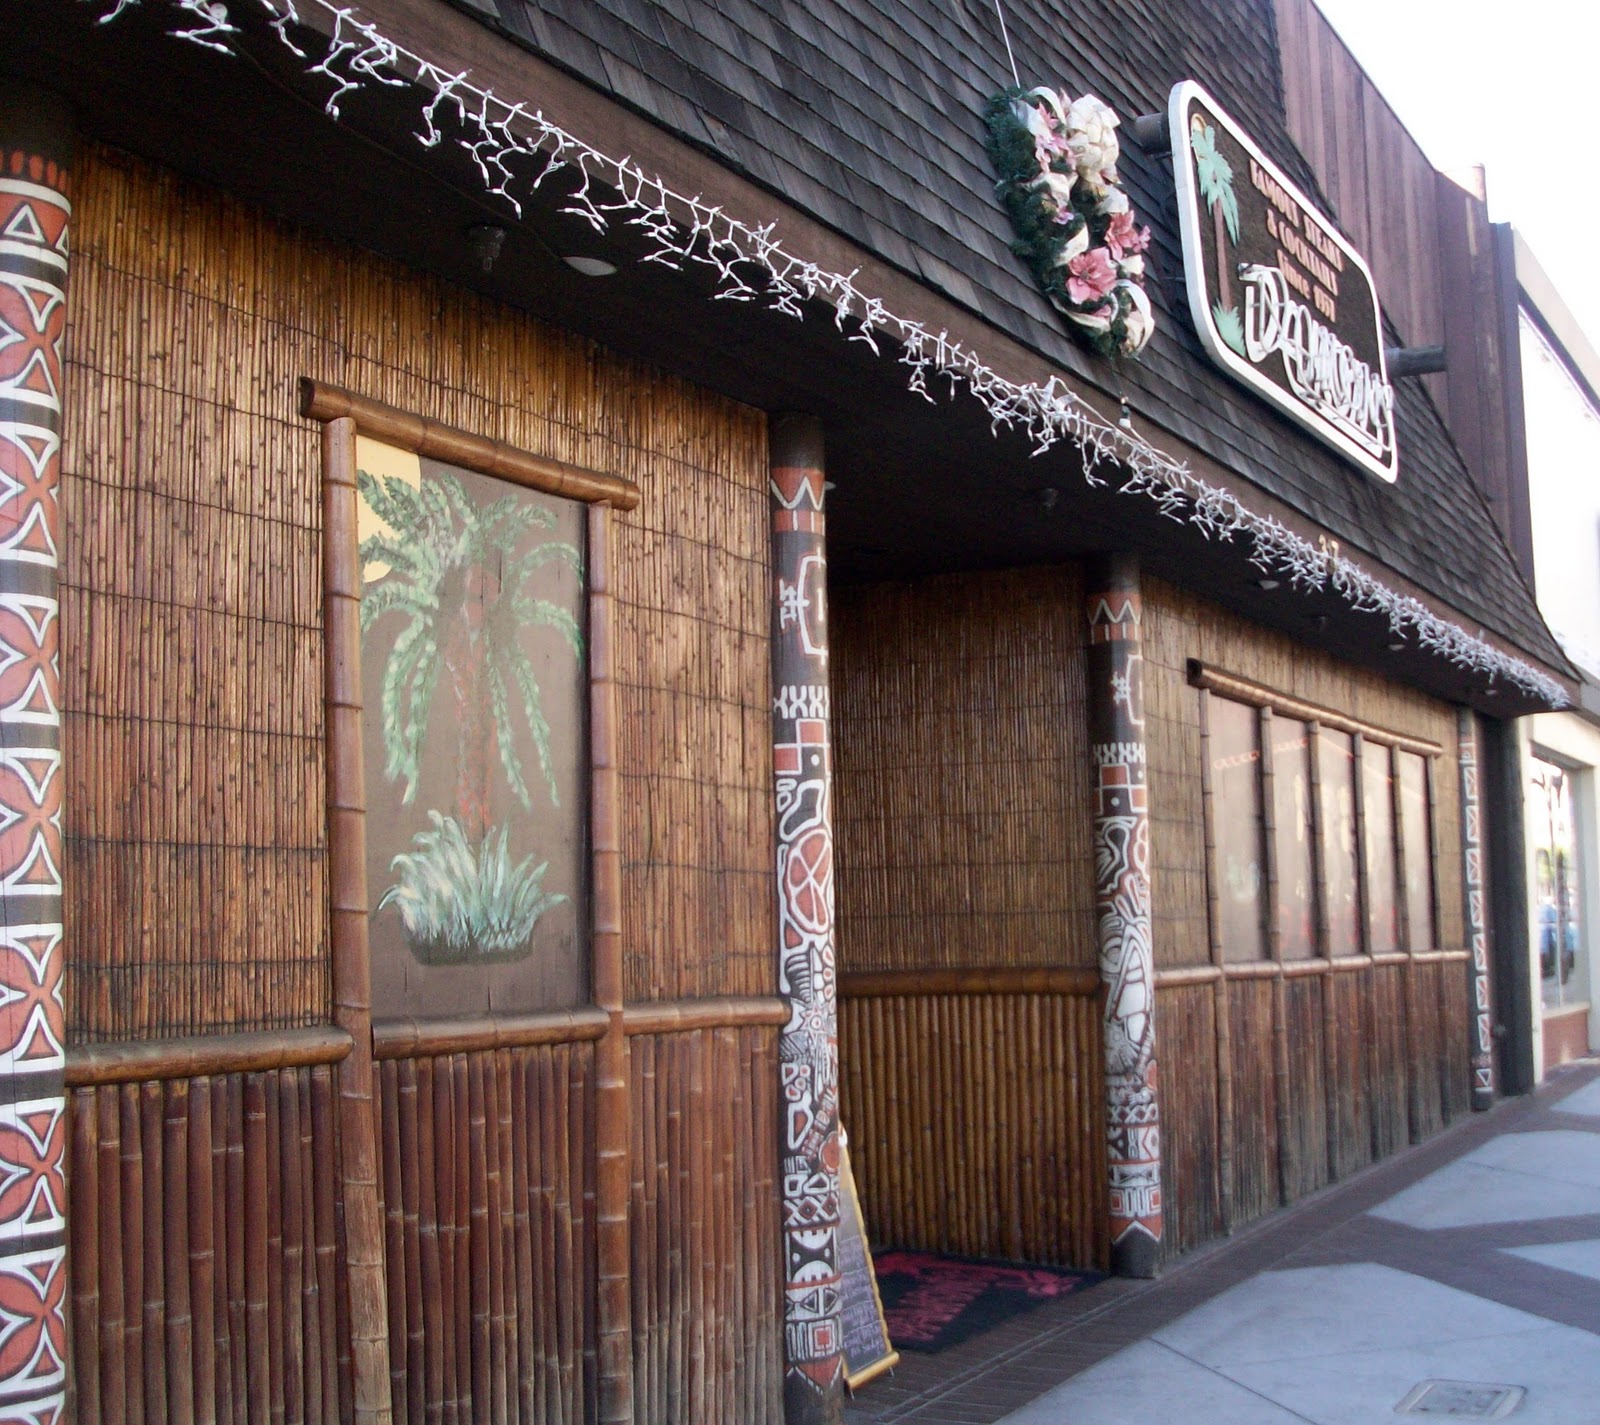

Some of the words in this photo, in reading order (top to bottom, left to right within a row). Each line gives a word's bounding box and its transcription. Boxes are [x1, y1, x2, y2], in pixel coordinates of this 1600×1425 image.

[1250, 158, 1300, 228] FAMOUS
[1303, 214, 1344, 272] STEAKS
[1267, 208, 1279, 240] &
